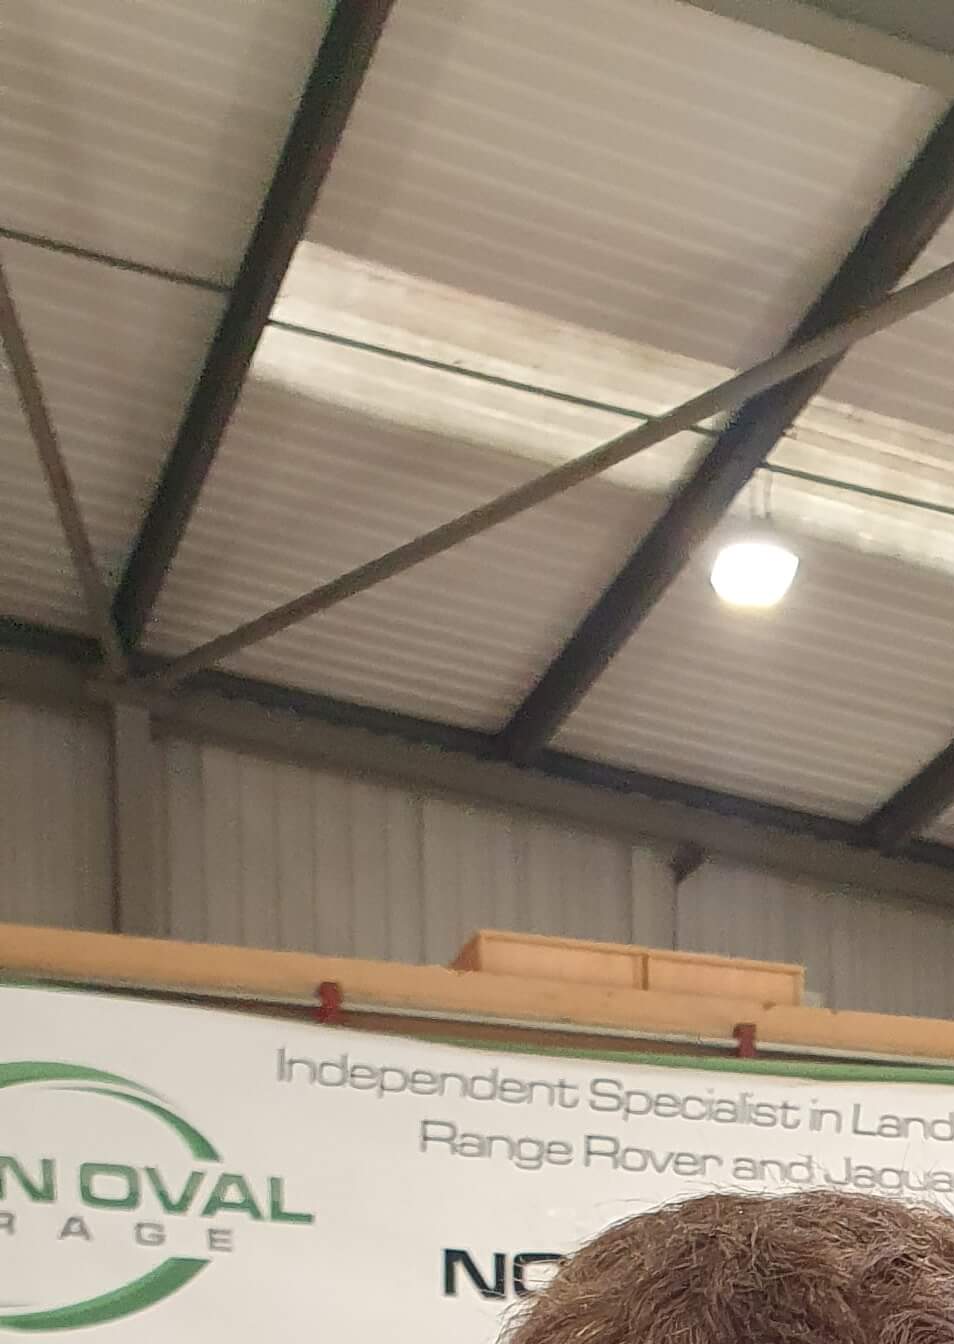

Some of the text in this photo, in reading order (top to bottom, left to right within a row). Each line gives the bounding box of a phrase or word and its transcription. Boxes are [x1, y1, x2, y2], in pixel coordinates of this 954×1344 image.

[277, 1047, 579, 1109] Independent
[588, 1077, 801, 1130] Specialist
[808, 1098, 843, 1134] in
[418, 1118, 574, 1171] Range
[583, 1133, 724, 1177] Rover
[731, 1154, 813, 1184] and
[78, 1161, 316, 1224] OVAL
